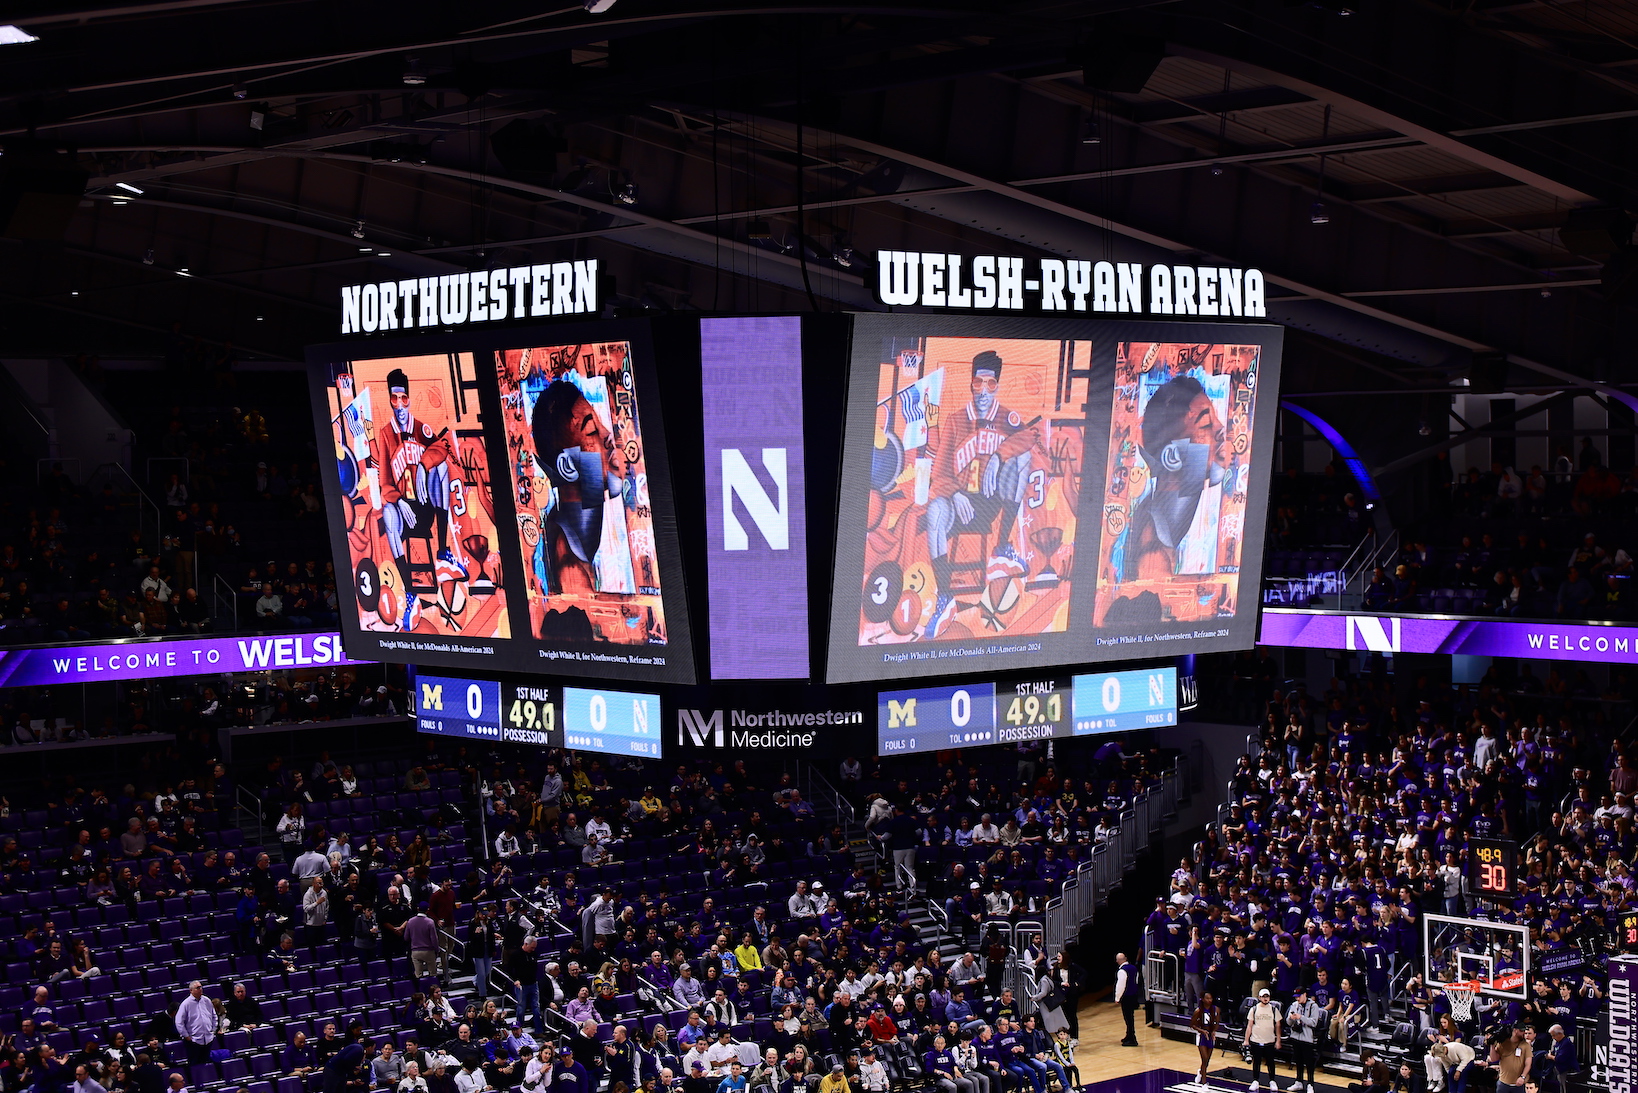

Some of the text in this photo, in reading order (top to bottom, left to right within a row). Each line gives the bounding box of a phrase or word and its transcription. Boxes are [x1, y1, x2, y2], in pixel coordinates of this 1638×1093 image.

[877, 250, 1267, 318] WELSH-RYAN ARENA
[341, 258, 598, 334] NORTHWESTERN
[450, 478, 466, 517] 3
[721, 447, 790, 551] N
[1028, 469, 1045, 509] 3
[360, 571, 373, 596] 3
[871, 577, 889, 605] 3
[381, 593, 390, 614] 1
[902, 599, 910, 623] 1
[922, 600, 932, 616] 2
[1096, 638, 1119, 646] Dwight
[1120, 636, 1137, 644] White
[1144, 634, 1153, 642] for
[1154, 632, 1193, 641] Northwestern,
[1193, 630, 1216, 638] Reframe
[1346, 616, 1400, 652] N
[379, 640, 397, 650] Dwight
[397, 641, 410, 649] White
[416, 642, 424, 650] for
[424, 643, 450, 652] McDonalds
[451, 644, 483, 654] All-American
[483, 646, 494, 655] 2024
[539, 650, 559, 660] Dwight
[559, 651, 575, 660] White
[591, 653, 629, 664] Northwestern,
[629, 655, 652, 664] Reframe
[652, 657, 666, 666] 2024
[884, 654, 909, 663] Dwight
[910, 652, 930, 660] White
[938, 649, 948, 658] for
[949, 648, 985, 657] McDonalds
[986, 645, 1027, 654] All-American
[1027, 643, 1041, 651] 2024
[52, 651, 177, 674] WELCOME
[192, 649, 221, 664] TO
[422, 683, 443, 711] M
[516, 686, 549, 702] 1ST HALF
[1016, 681, 1055, 696] 1ST HALF
[1102, 677, 1120, 712] 0
[1149, 674, 1164, 706] N
[466, 684, 482, 719] 0
[951, 689, 971, 727] 0
[590, 695, 607, 732] 0
[633, 699, 648, 733] N
[731, 710, 863, 728] Northwestern
[887, 698, 917, 728] M
[1105, 718, 1117, 728] TOL
[1145, 712, 1173, 724] FOULS 0
[421, 719, 443, 731] FOULS 0
[466, 724, 476, 734] TOL
[999, 725, 1053, 742] POSSESSION
[504, 728, 548, 745] POSSESSION
[593, 737, 604, 748] TOL
[885, 738, 916, 750] FOULS 0
[950, 734, 962, 744] TOL
[630, 741, 657, 755] FOULS 0
[1476, 847, 1503, 863] 48.9
[1481, 863, 1506, 890] 30
[1627, 929, 1637, 943] 30
[1374, 953, 1382, 969] 1
[1588, 987, 1595, 999] 0
[1609, 978, 1631, 1093] WILDCATS
[1630, 991, 1638, 1087] NORTHWESTERN
[1595, 1044, 1607, 1066] N
